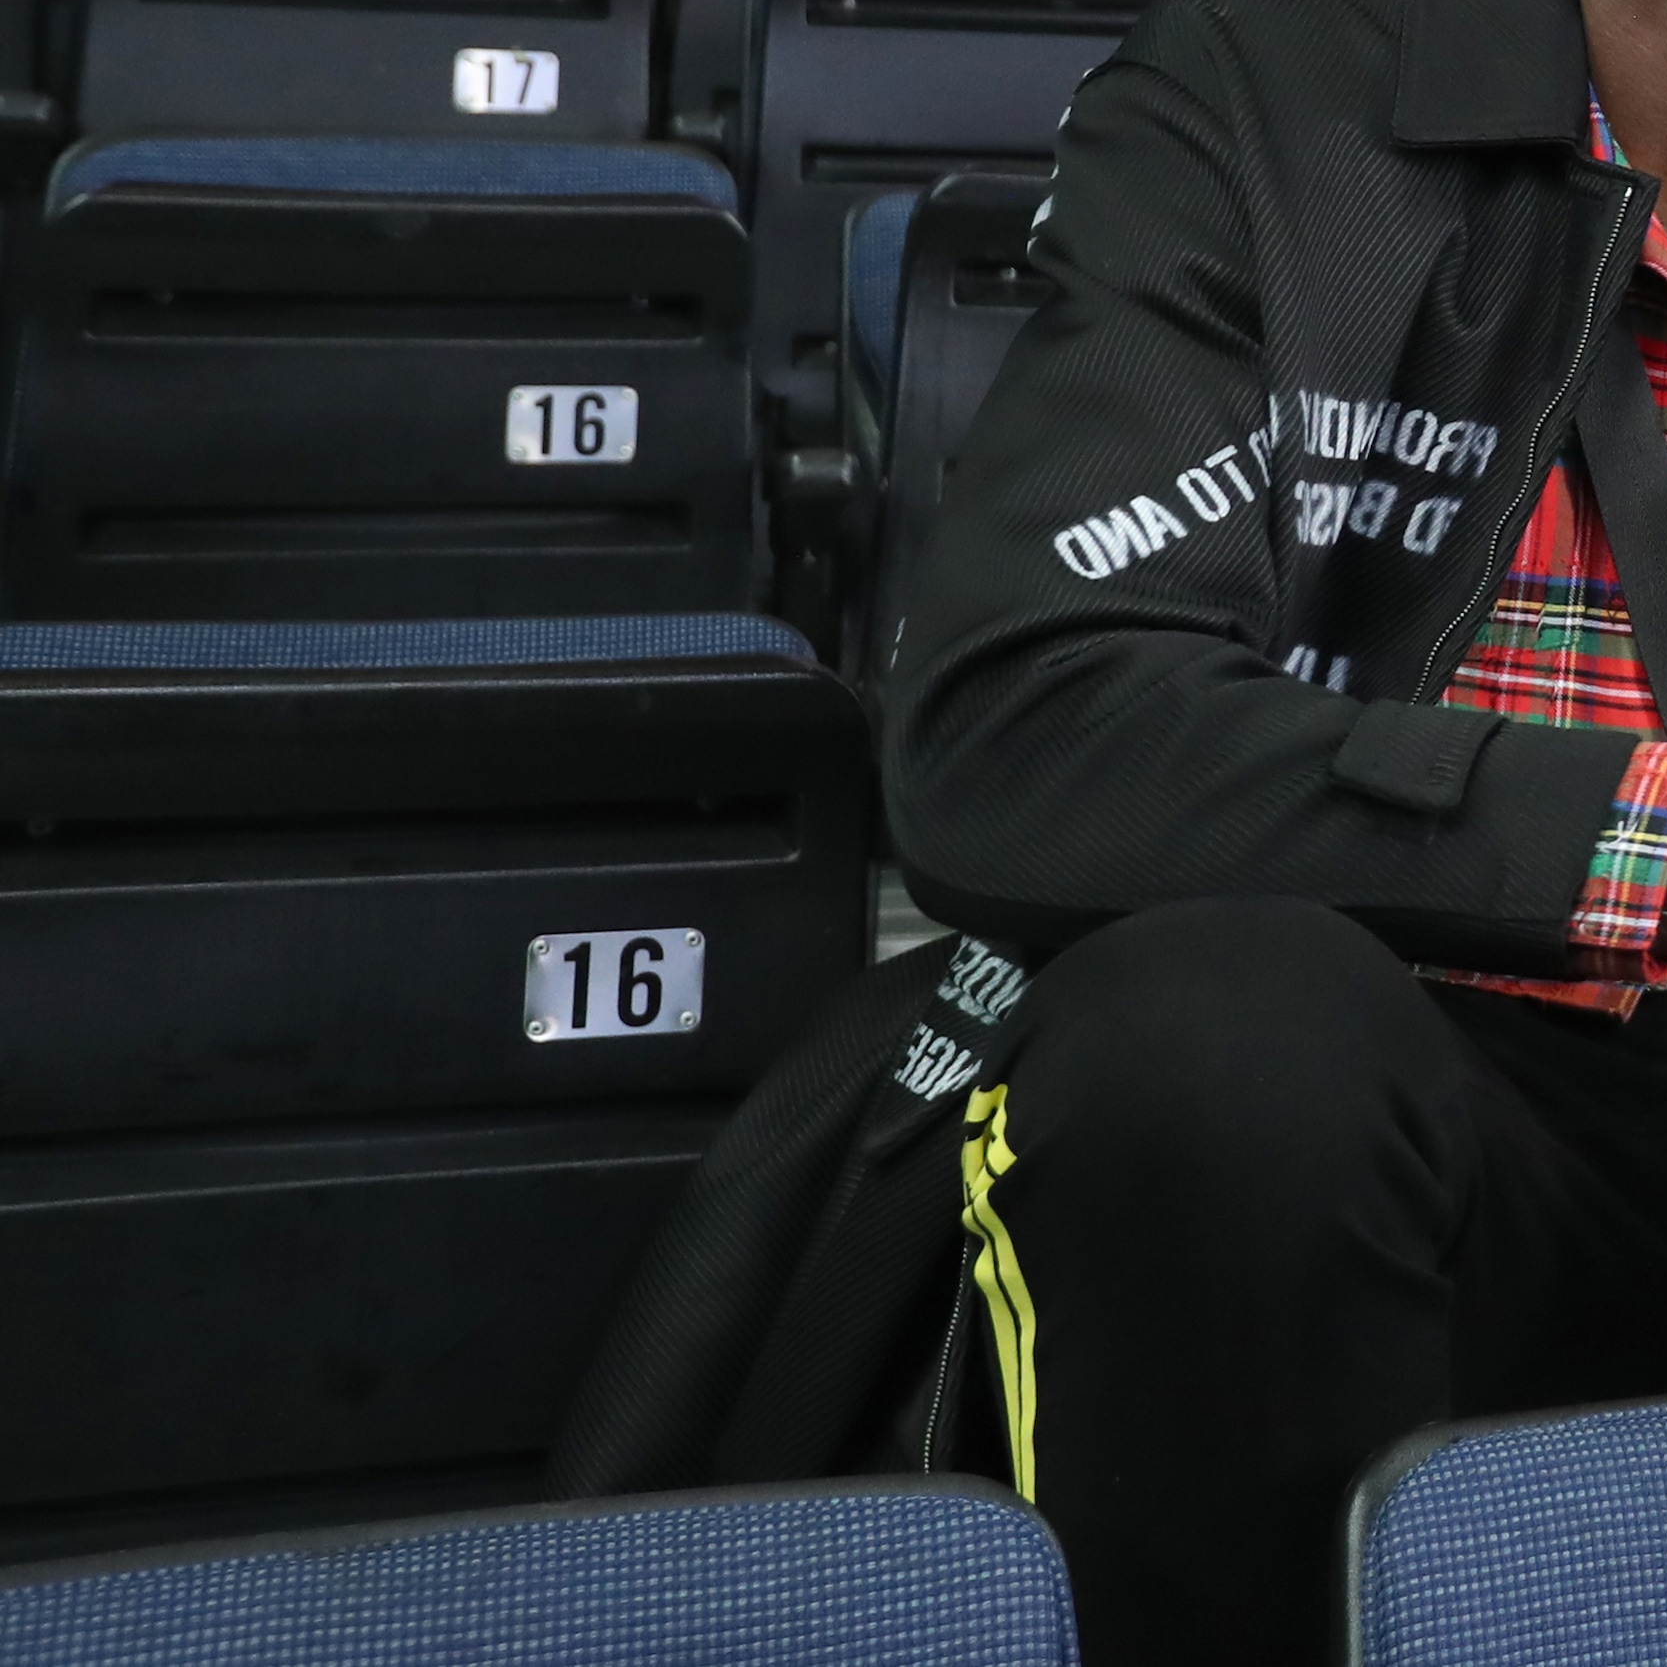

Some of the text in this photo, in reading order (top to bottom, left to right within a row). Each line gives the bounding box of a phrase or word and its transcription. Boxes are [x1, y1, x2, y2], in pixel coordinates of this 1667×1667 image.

[482, 55, 536, 106] 17
[536, 393, 607, 458] 16
[563, 936, 665, 1030] 16
